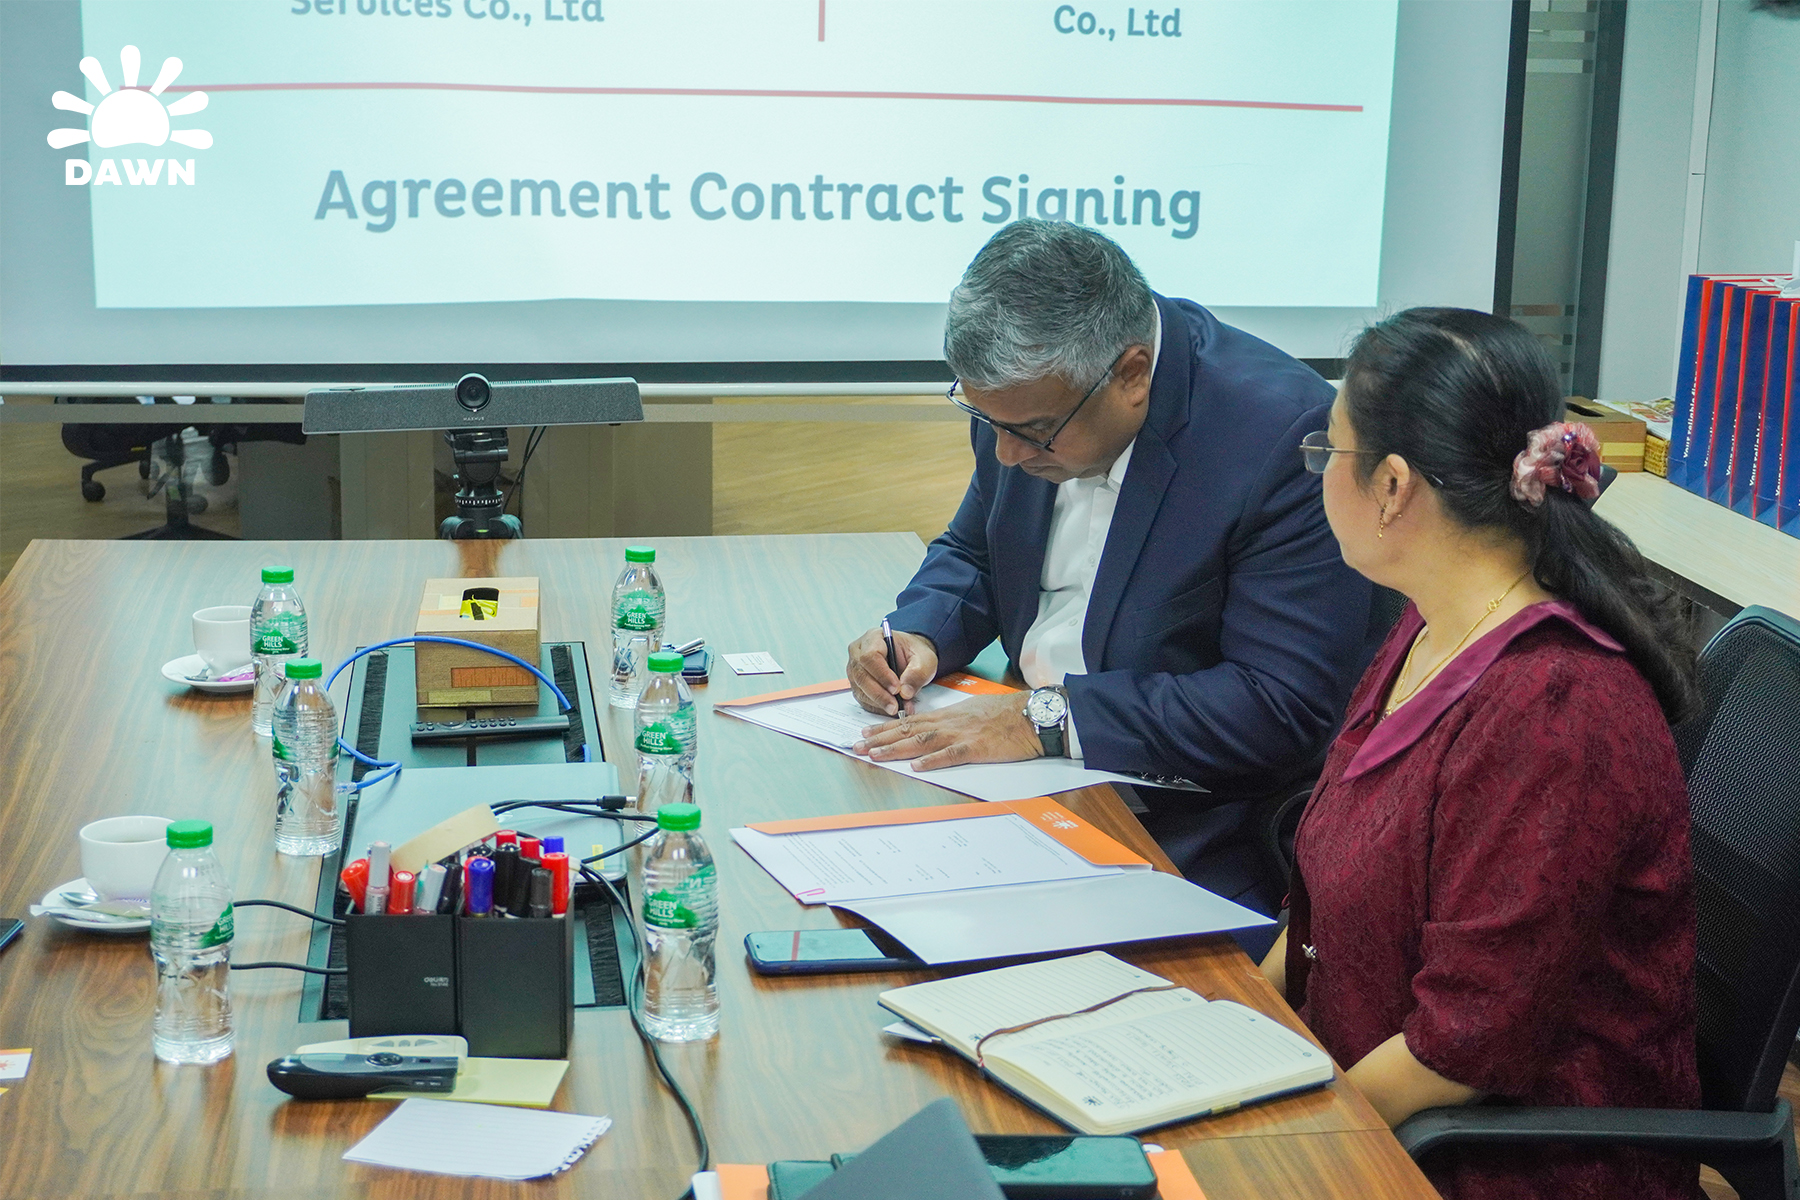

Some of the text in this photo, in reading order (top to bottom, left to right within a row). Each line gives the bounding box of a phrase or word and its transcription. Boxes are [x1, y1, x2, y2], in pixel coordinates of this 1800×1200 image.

[463, 0, 532, 27] Co.,
[544, 0, 605, 22] Ltd
[1053, 4, 1182, 41] Co., Ltd
[313, 169, 1201, 240] Agreement Contract Signing
[626, 611, 647, 619] GREEN
[641, 730, 667, 740] GREEN
[643, 737, 665, 746] HILLS
